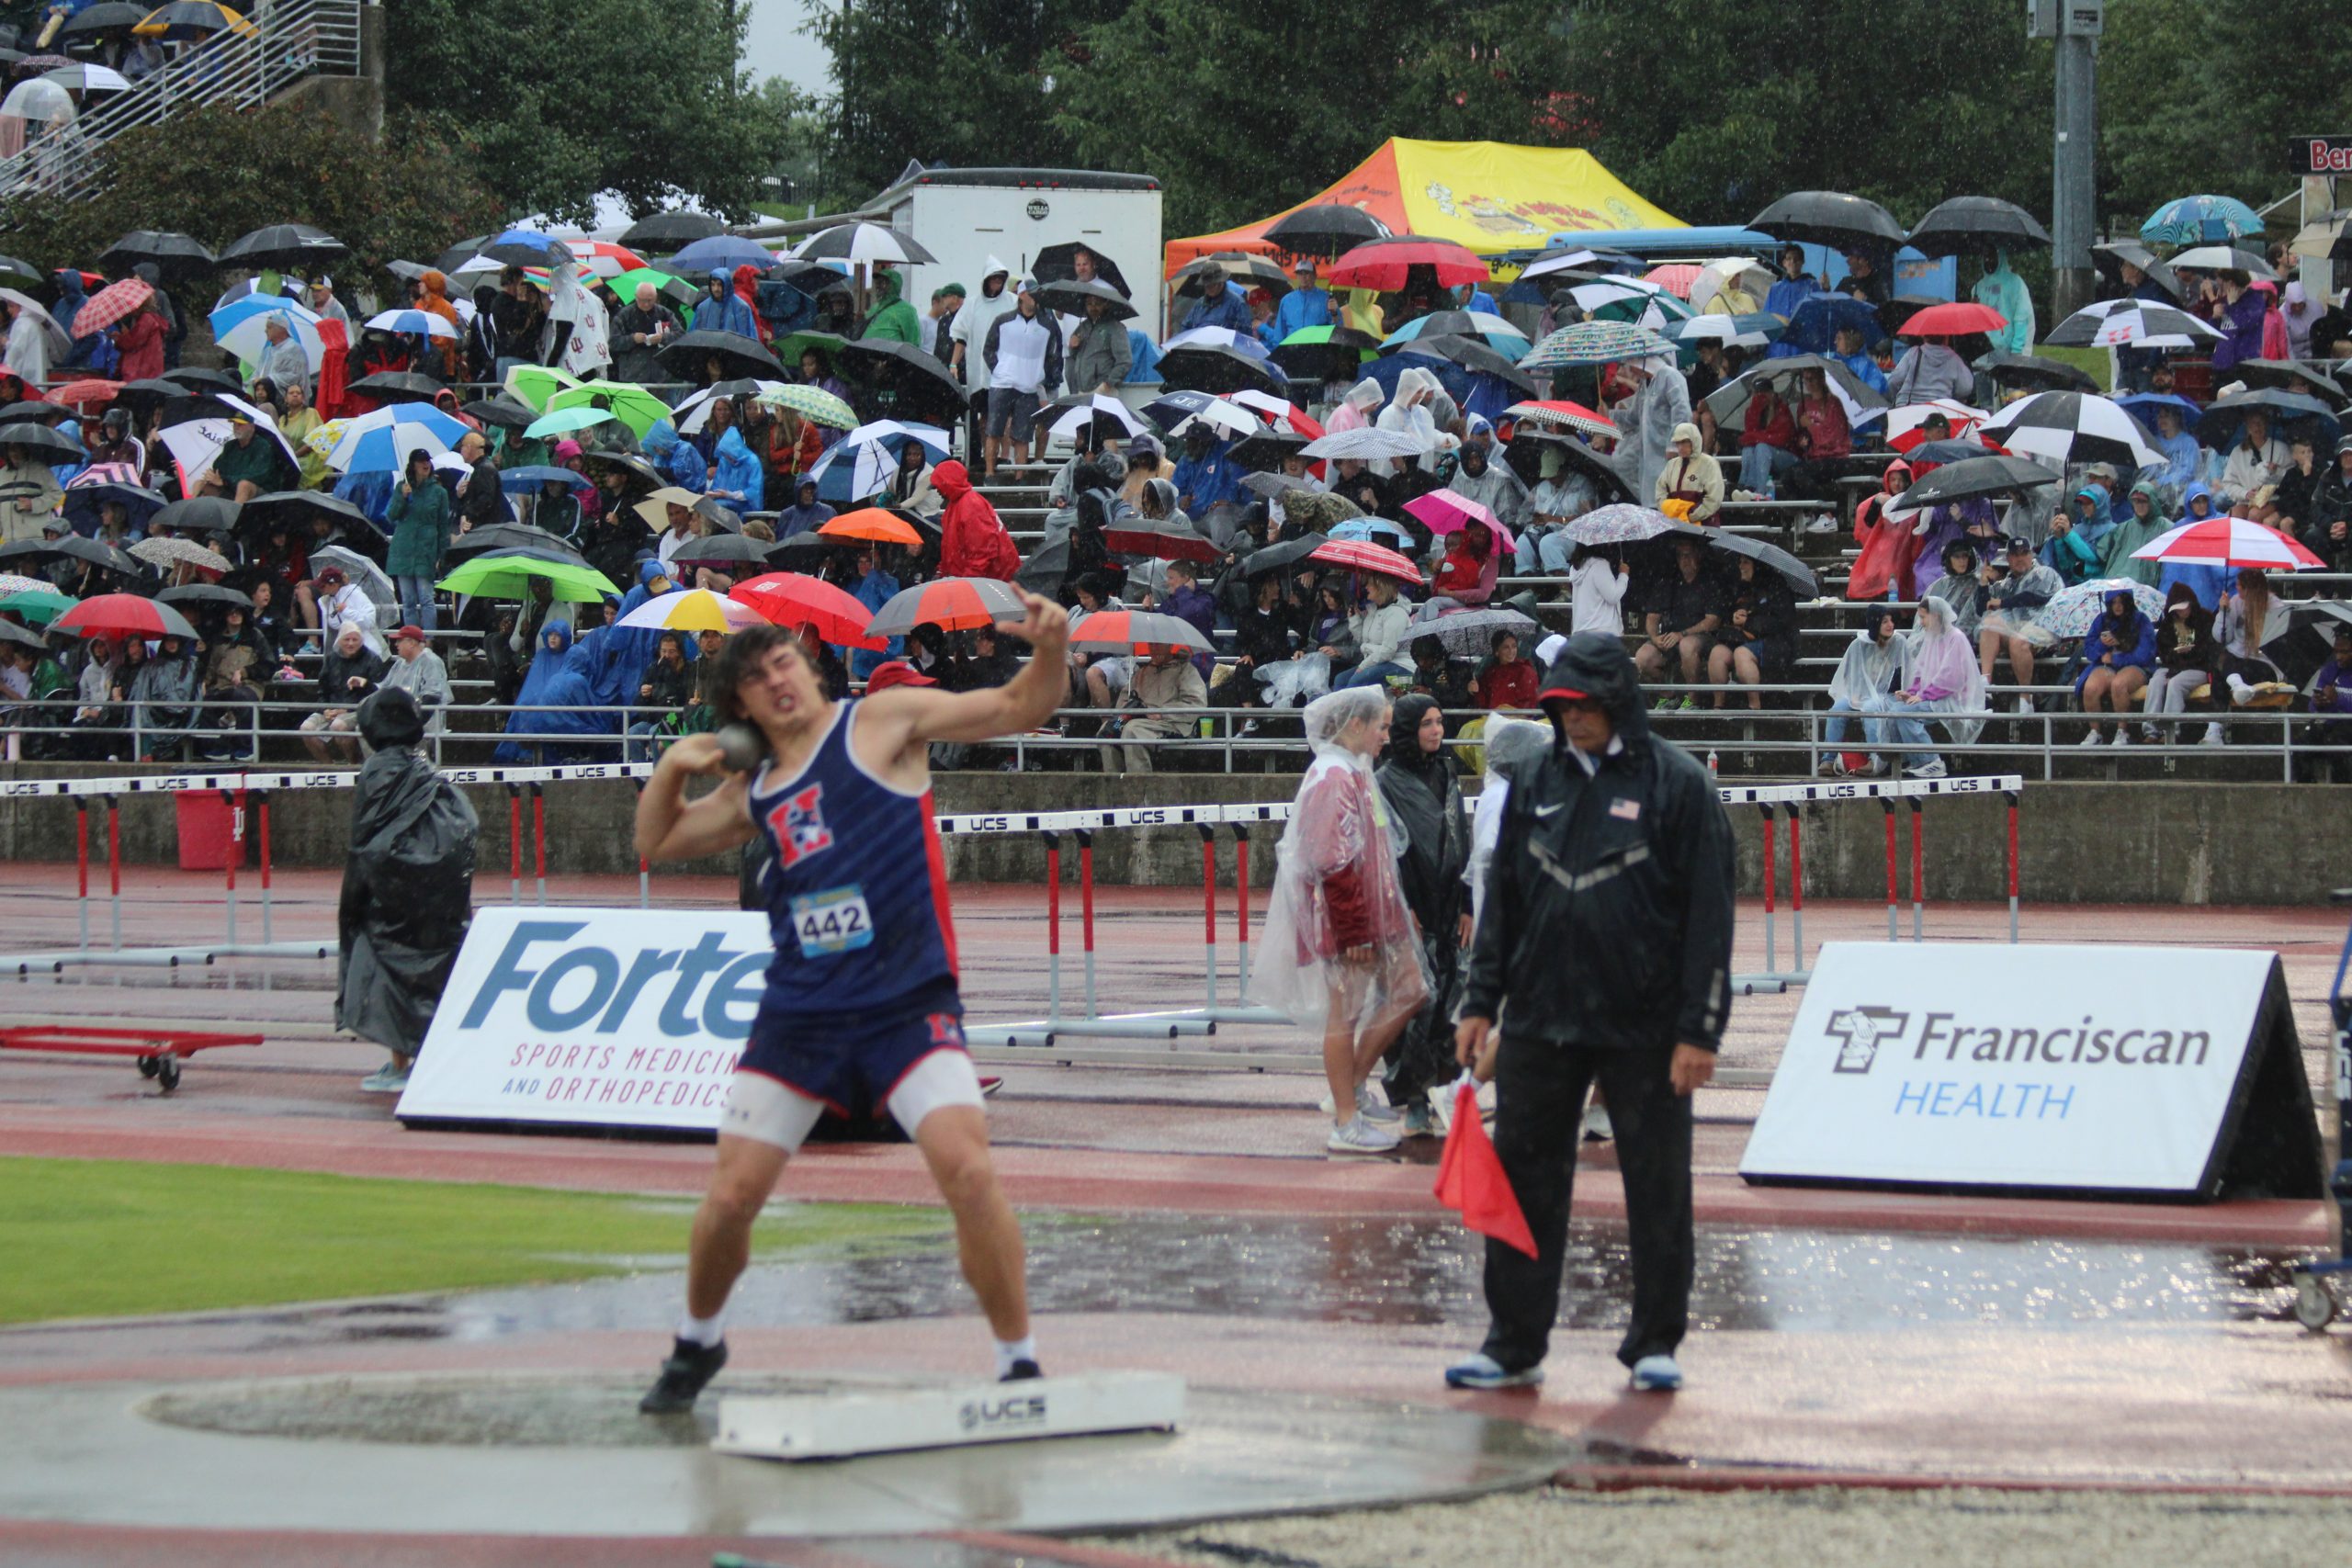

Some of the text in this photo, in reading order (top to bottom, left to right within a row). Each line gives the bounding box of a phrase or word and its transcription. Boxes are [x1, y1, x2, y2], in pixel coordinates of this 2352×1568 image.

[575, 767, 605, 778] UCS
[154, 779, 188, 791] UCS
[304, 774, 337, 786] UCS
[1950, 779, 1978, 792] UCS
[6, 783, 40, 795] UCS
[1827, 784, 1856, 798] UCS
[970, 817, 1008, 831] UCS
[1129, 810, 1165, 824] UCS
[803, 907, 864, 940] 442
[458, 920, 775, 1040] Forte
[1914, 1012, 2211, 1066] Franciscan
[510, 1043, 739, 1076] SPORTS MEDICIN
[502, 1078, 541, 1095] AND
[1894, 1081, 2075, 1120] HEALTH
[981, 1396, 1046, 1422] UCS
